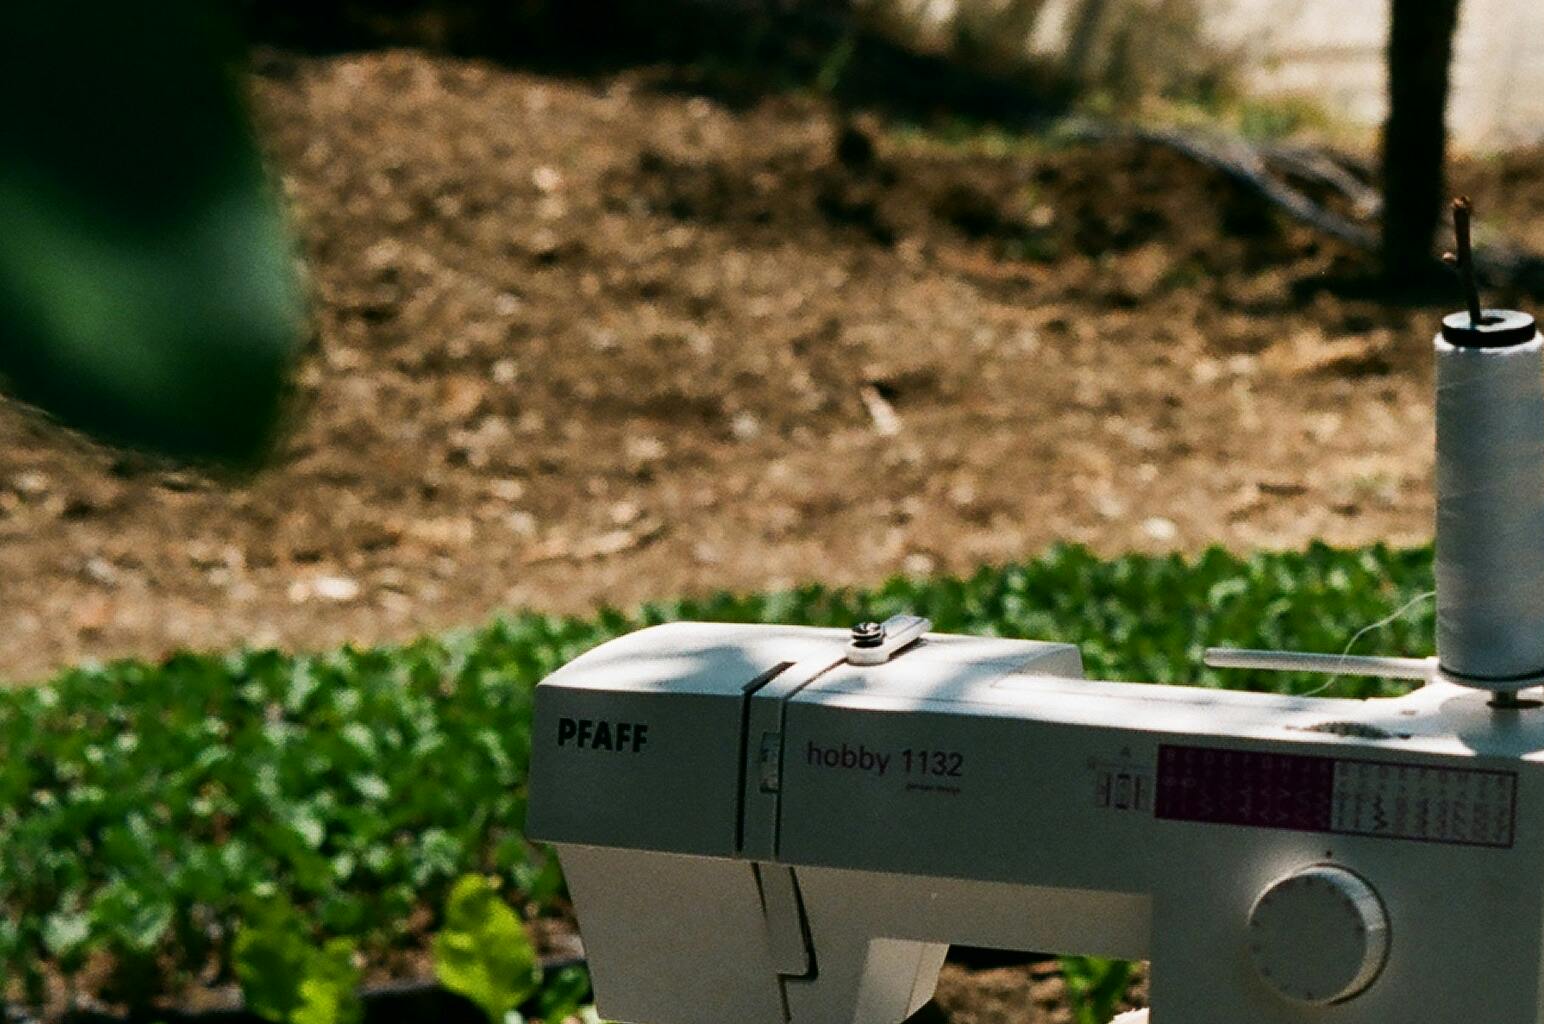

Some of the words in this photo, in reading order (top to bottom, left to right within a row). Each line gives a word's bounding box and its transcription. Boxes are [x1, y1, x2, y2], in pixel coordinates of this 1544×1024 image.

[557, 718, 648, 753] PFAFF
[807, 741, 890, 775] hobby
[902, 748, 964, 777] 1132
